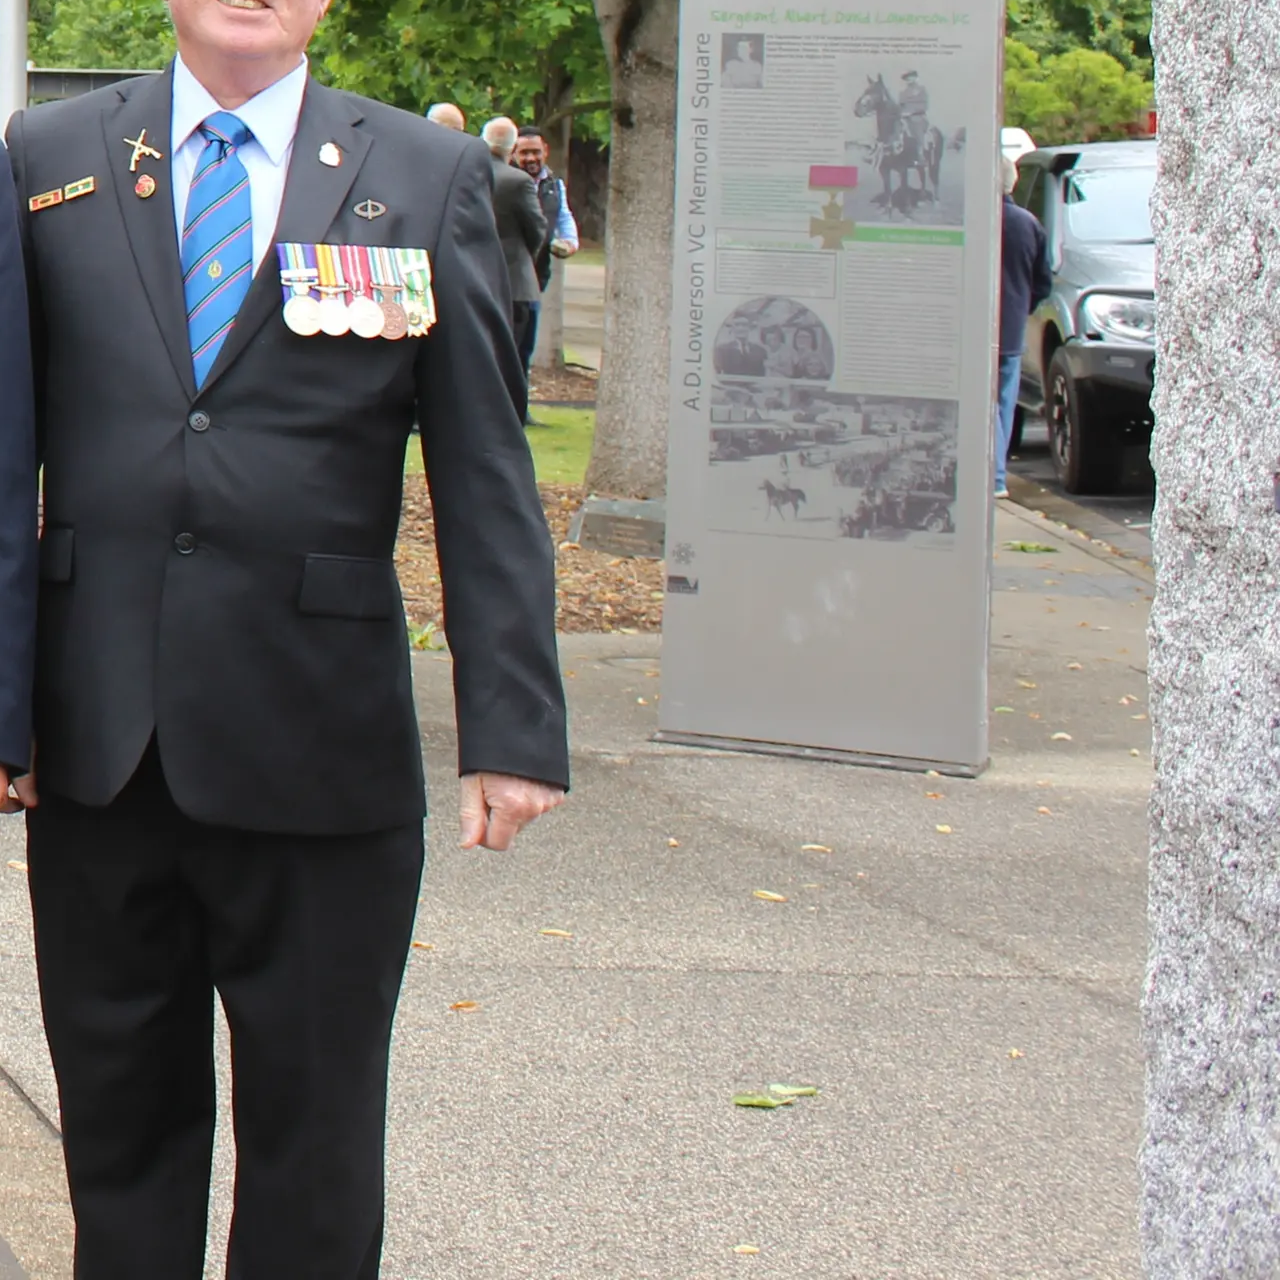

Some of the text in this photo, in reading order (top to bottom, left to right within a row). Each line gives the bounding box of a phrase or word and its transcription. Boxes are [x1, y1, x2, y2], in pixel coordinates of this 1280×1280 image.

[691, 32, 713, 109] Square
[688, 118, 709, 215] Memorial
[687, 223, 706, 253] VC
